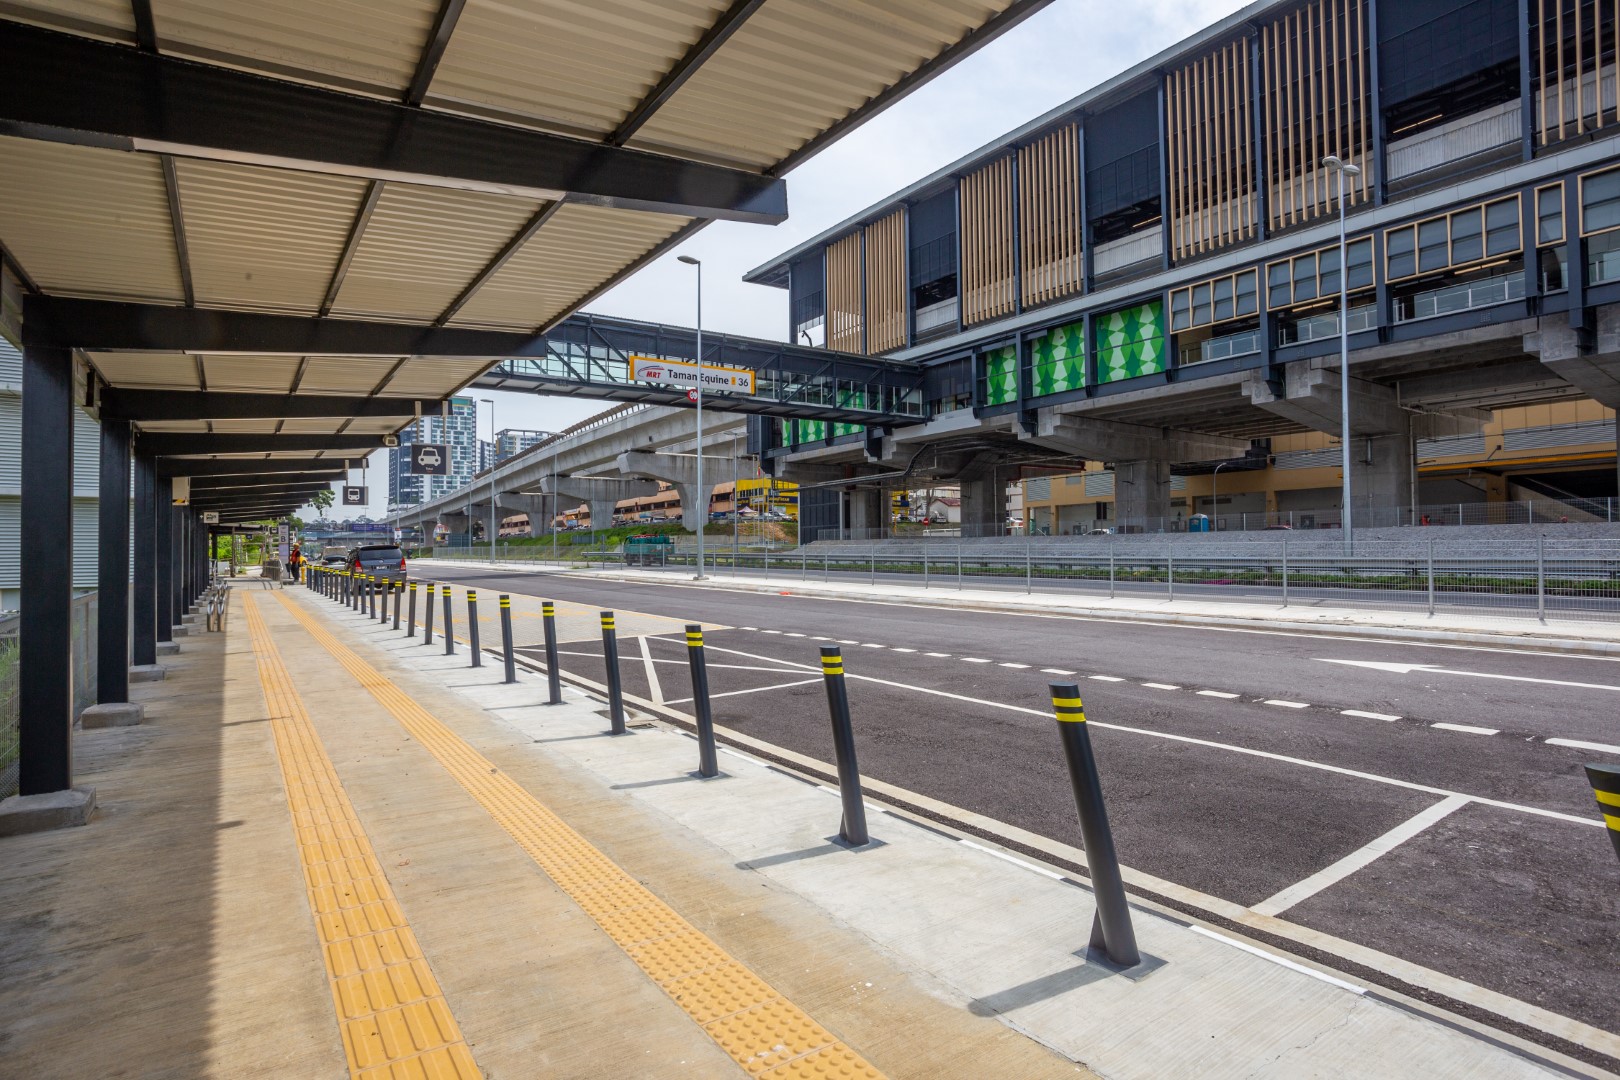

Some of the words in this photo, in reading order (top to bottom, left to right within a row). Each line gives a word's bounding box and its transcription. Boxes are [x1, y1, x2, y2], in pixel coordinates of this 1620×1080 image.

[667, 369, 697, 381] Taman
[700, 373, 729, 384] Equine
[738, 378, 749, 387] 36
